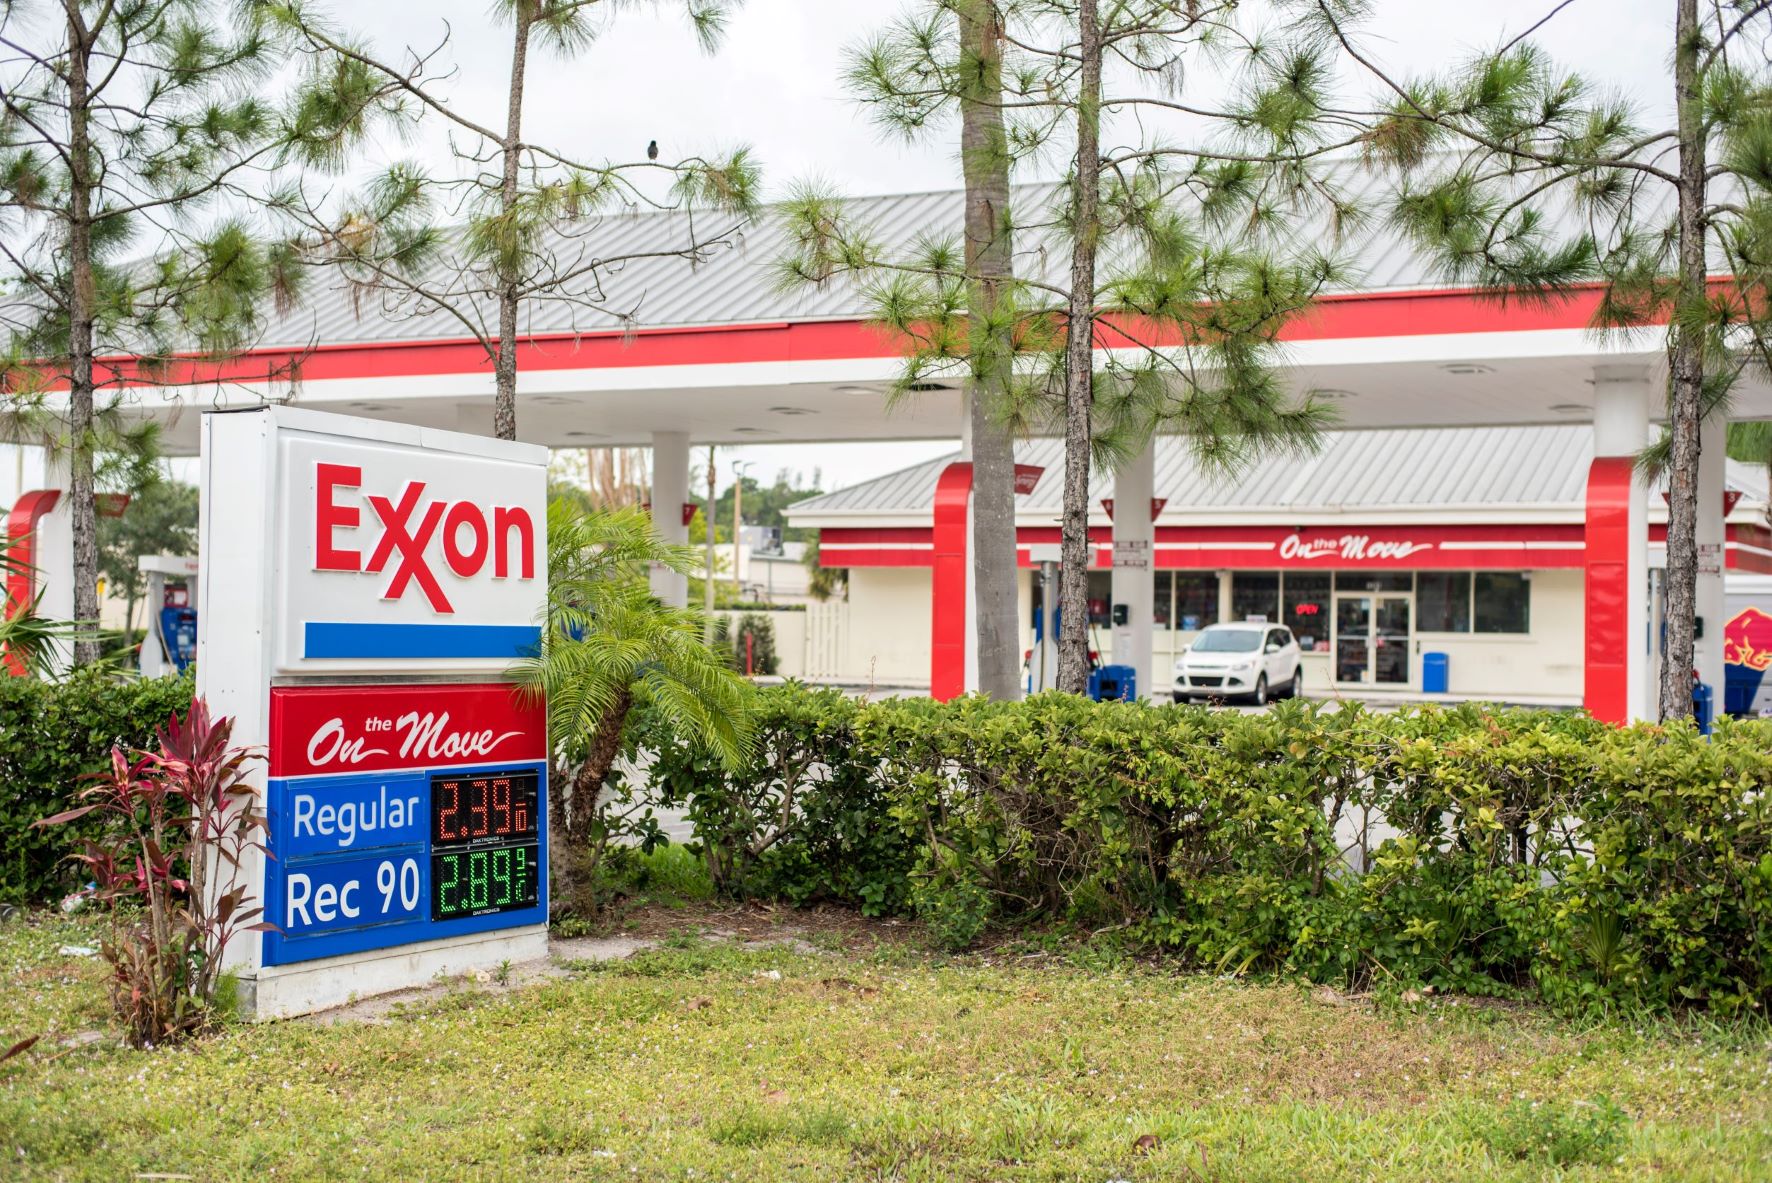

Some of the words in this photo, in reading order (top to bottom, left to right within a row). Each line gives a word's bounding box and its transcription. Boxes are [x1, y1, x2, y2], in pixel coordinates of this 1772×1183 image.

[315, 463, 534, 614] Exxon
[1279, 534, 1338, 560] On
[1313, 538, 1338, 550] the
[1339, 535, 1433, 560] Move
[1296, 604, 1319, 615] OPEN
[307, 717, 389, 766] On
[365, 716, 392, 732] the
[396, 711, 526, 760] Move
[294, 786, 419, 847] Regular
[287, 873, 360, 928] Rec
[376, 858, 420, 914] 90
